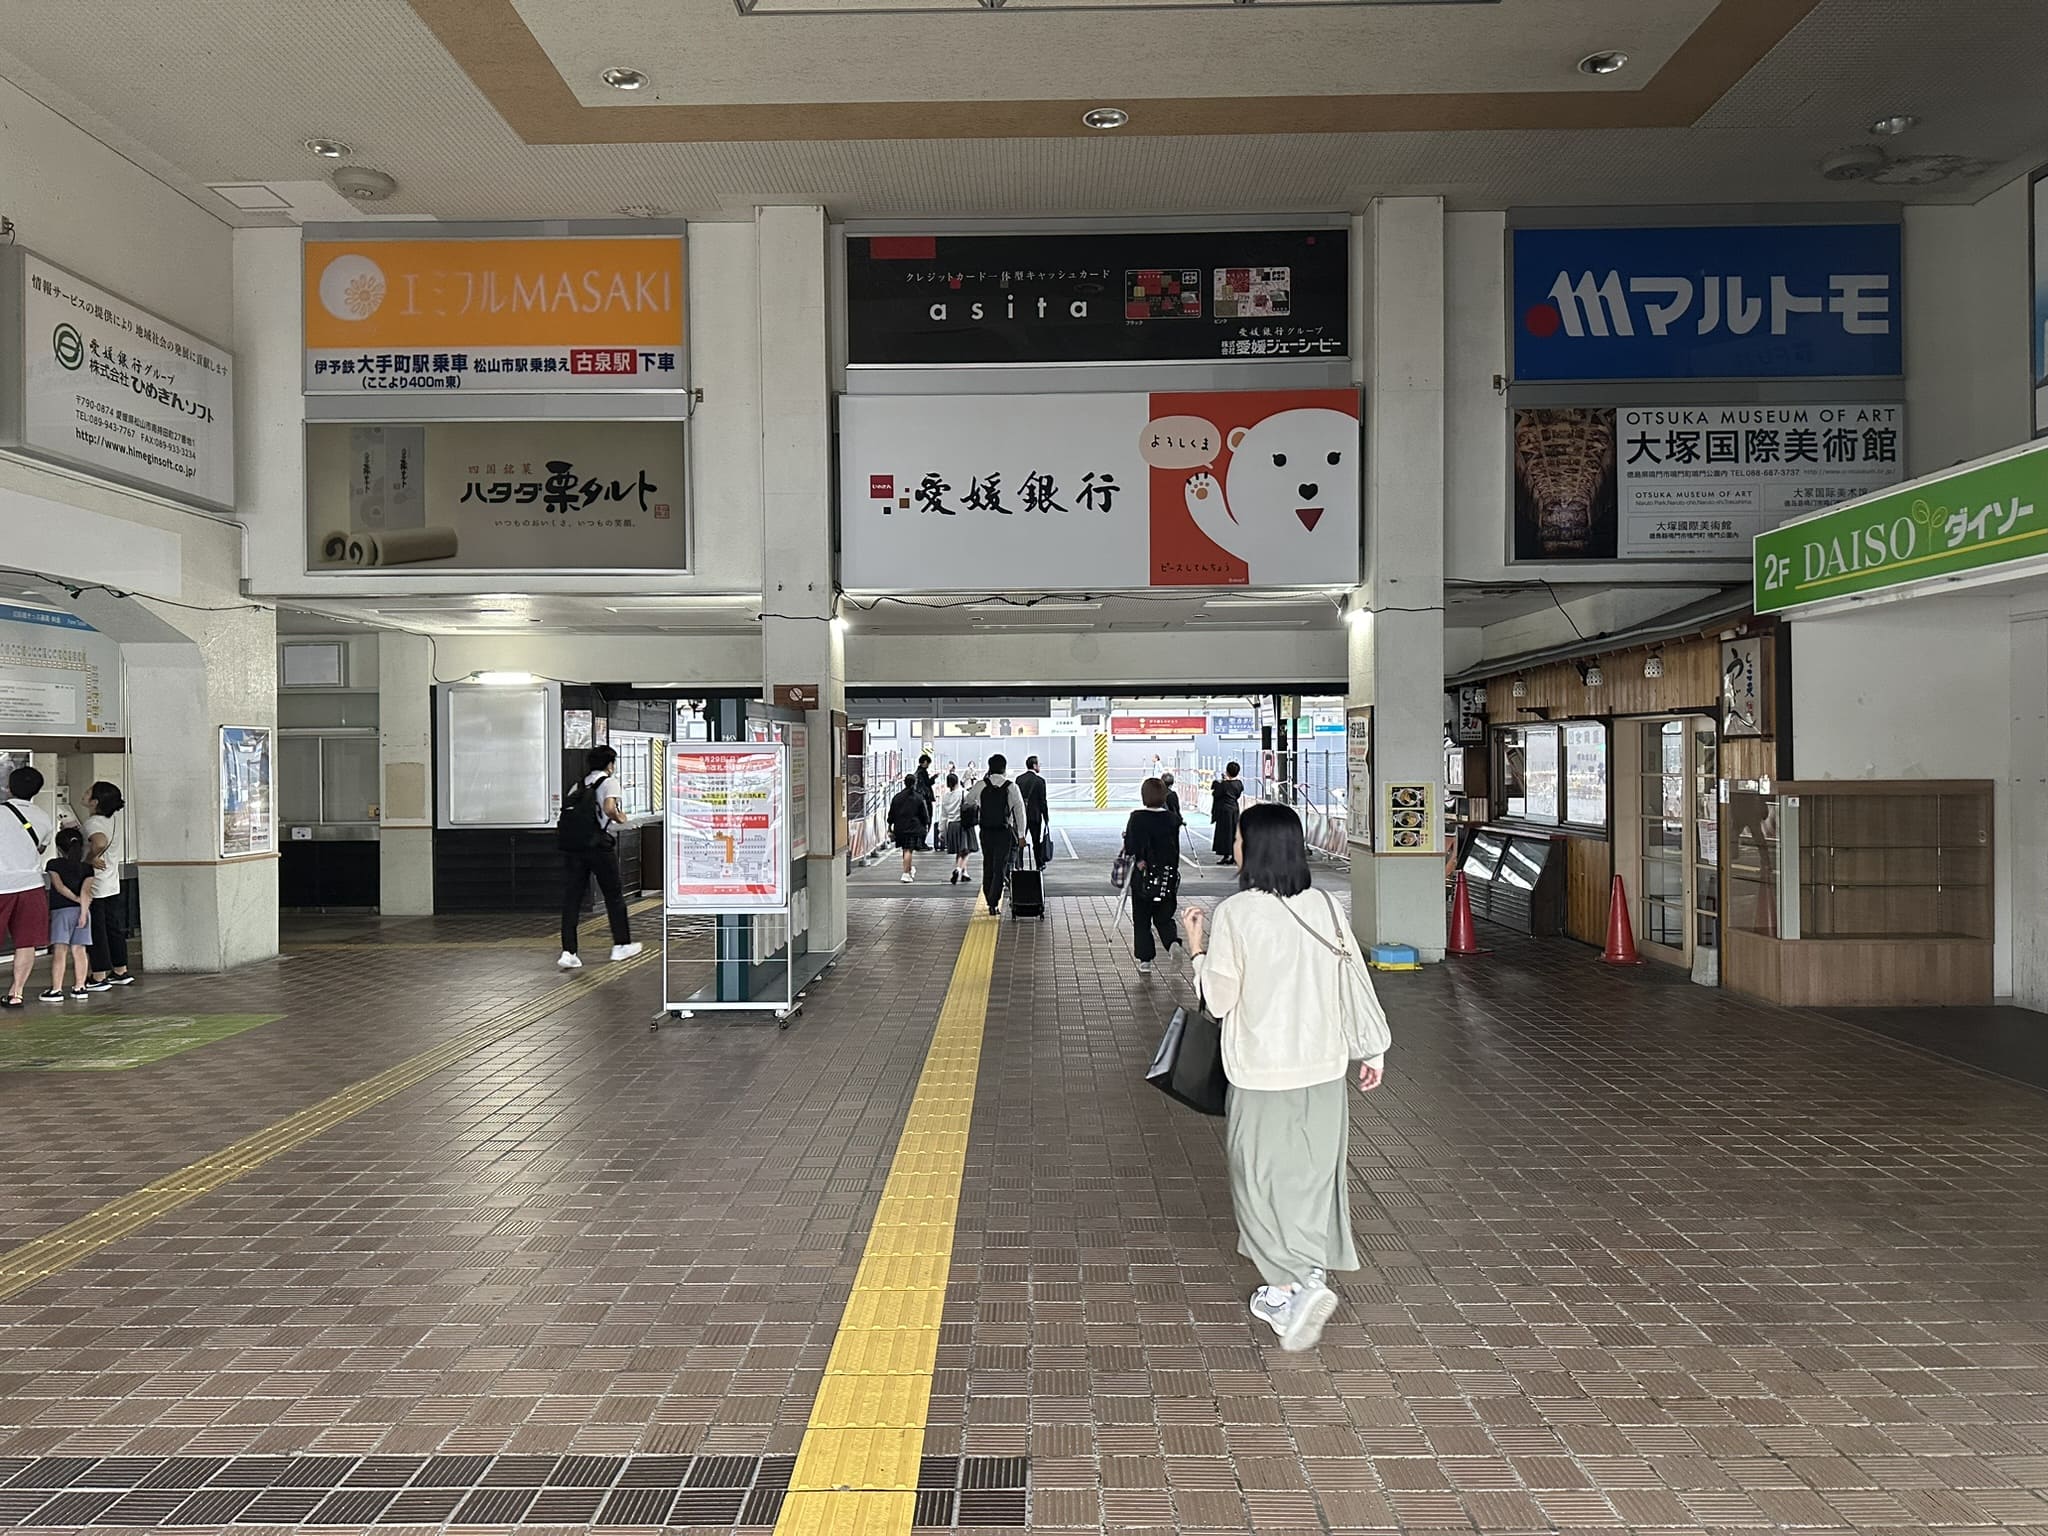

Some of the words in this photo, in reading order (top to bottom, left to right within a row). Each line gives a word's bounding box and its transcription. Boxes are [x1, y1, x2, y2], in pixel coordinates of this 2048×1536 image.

[929, 294, 1088, 321] asita
[1629, 274, 1889, 336] マルトモ
[576, 352, 632, 373] 古泉駅
[638, 351, 676, 373] 下車
[1626, 411, 1710, 425] OTSUKA
[1719, 409, 1808, 425] MUSEUM
[1818, 408, 1846, 424] OF
[1855, 407, 1896, 423] ART
[75, 427, 197, 479] http://www.himeginsoft.co.jp/
[1150, 434, 1209, 451] よろしくま
[1626, 427, 1898, 465] 大塚国際美術館
[914, 469, 1121, 516] 愛媛銀行
[1676, 490, 1715, 498] MUSEUM
[1944, 496, 2034, 548] ダイソー
[1764, 553, 1791, 591] 2F
[1803, 516, 1917, 582] DAISO
